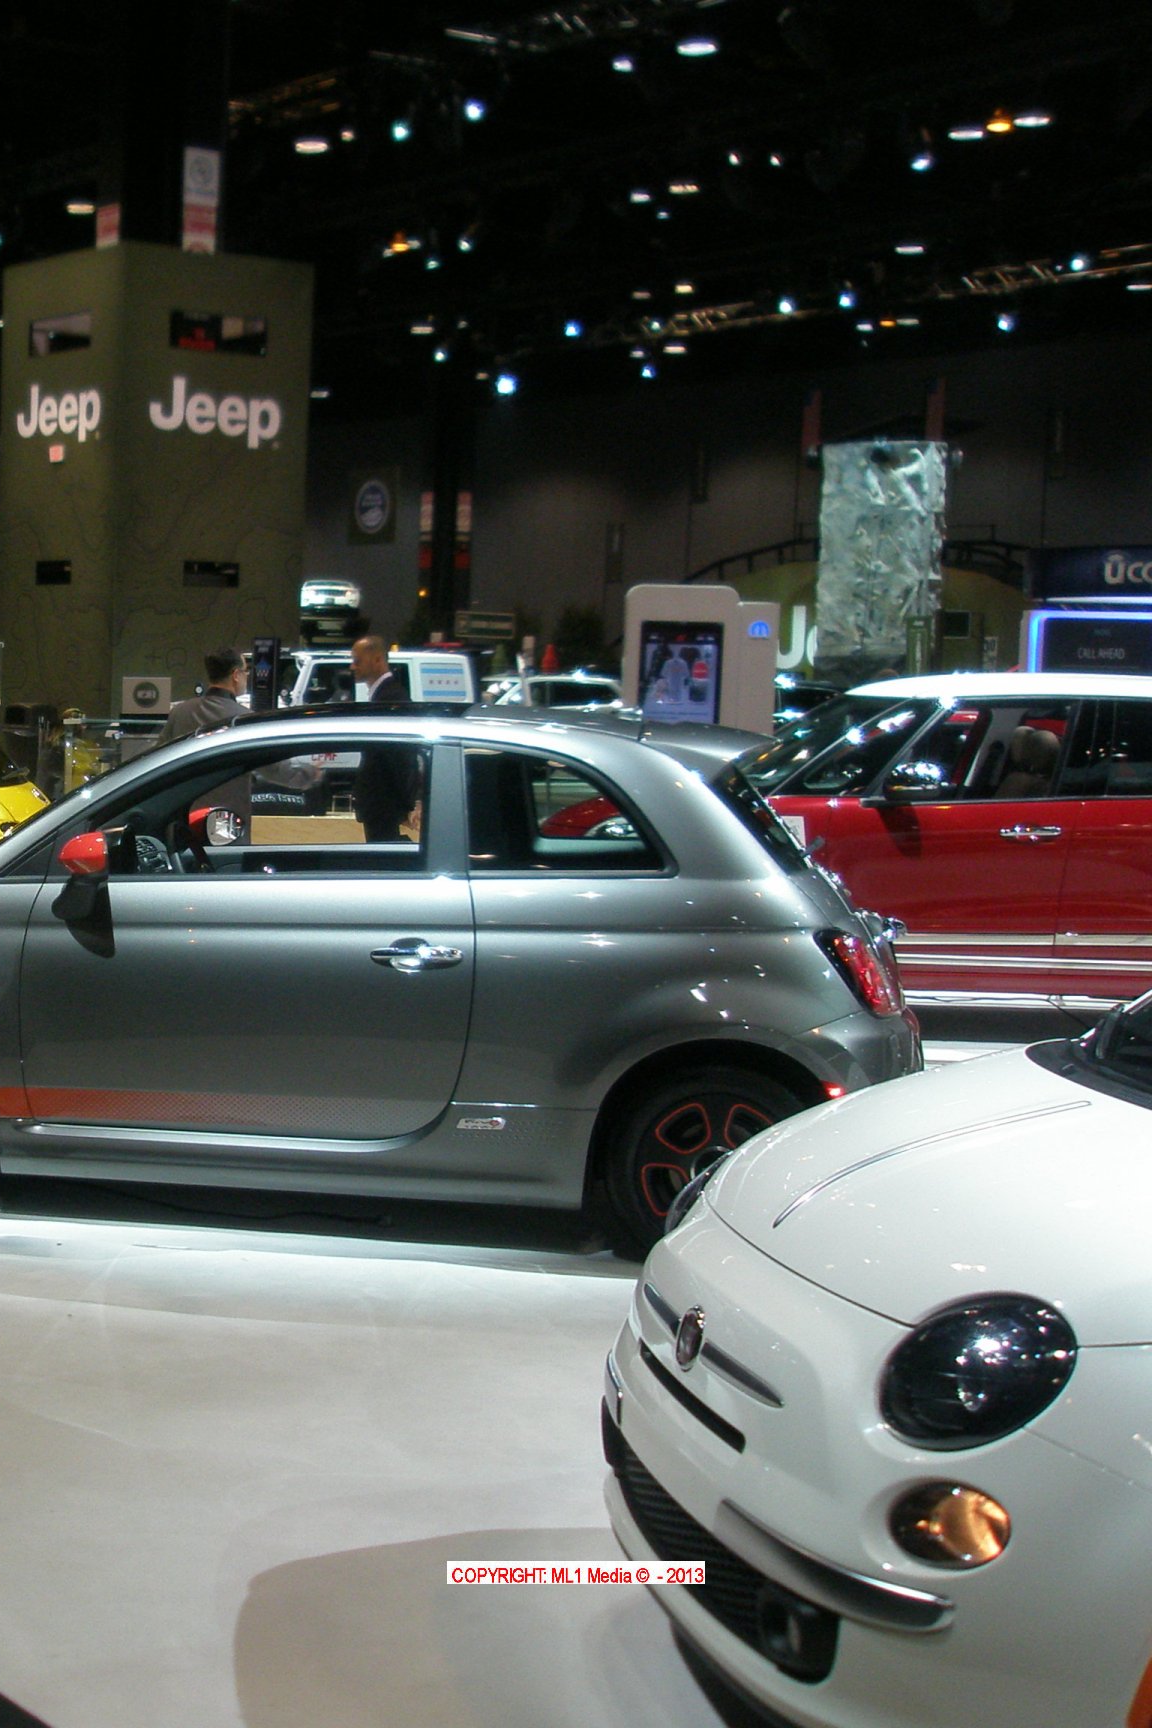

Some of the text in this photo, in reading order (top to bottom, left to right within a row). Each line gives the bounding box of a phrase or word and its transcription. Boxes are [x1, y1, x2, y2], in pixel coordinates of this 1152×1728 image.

[16, 384, 101, 442] Jeep
[149, 376, 281, 449] Jeep
[1077, 647, 1125, 660] CALL AHEAD
